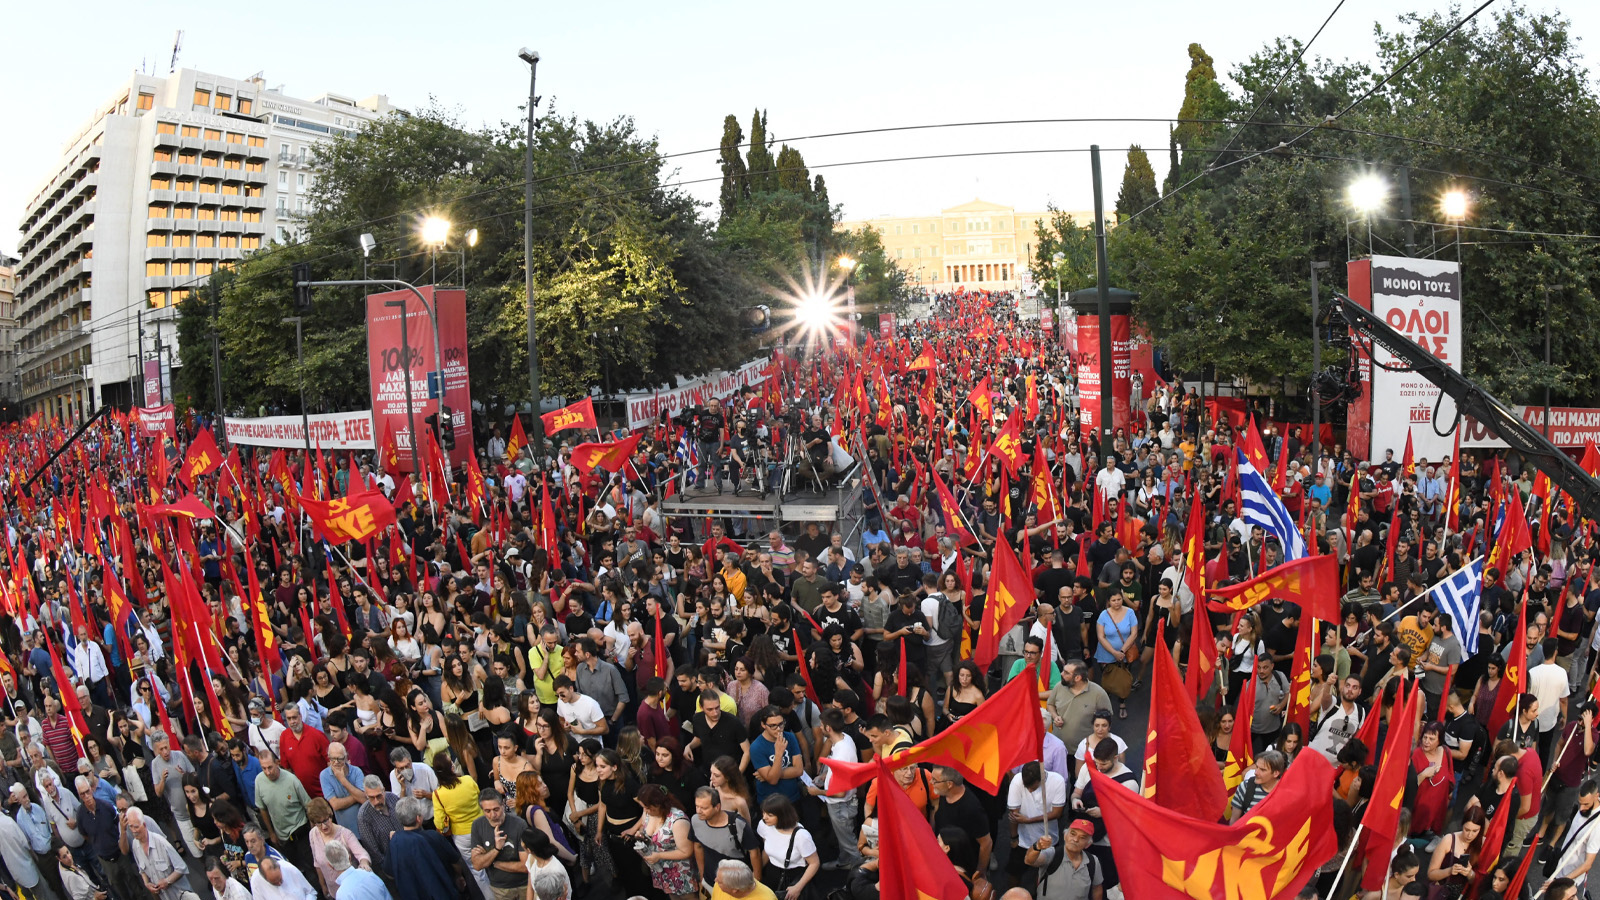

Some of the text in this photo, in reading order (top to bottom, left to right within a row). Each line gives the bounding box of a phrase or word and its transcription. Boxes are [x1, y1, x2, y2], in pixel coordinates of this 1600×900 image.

[186, 112, 230, 129] ATHENS
[1383, 278, 1451, 293] ΜΟΝΟΙ ΤΟΥΣ
[1418, 299, 1425, 307] &
[1386, 307, 1450, 335] ΟΛΟΙ
[1359, 327, 1413, 368] CINECRANE.GR
[1391, 335, 1448, 360] ΑΣ
[631, 399, 657, 423] ΚΚΕ
[1409, 409, 1431, 421] ΚΚΕ
[1553, 431, 1571, 445] ΠΙΟ
[324, 504, 377, 541] ΚΚΕ
[1161, 816, 1312, 900] ΚΚΕ
